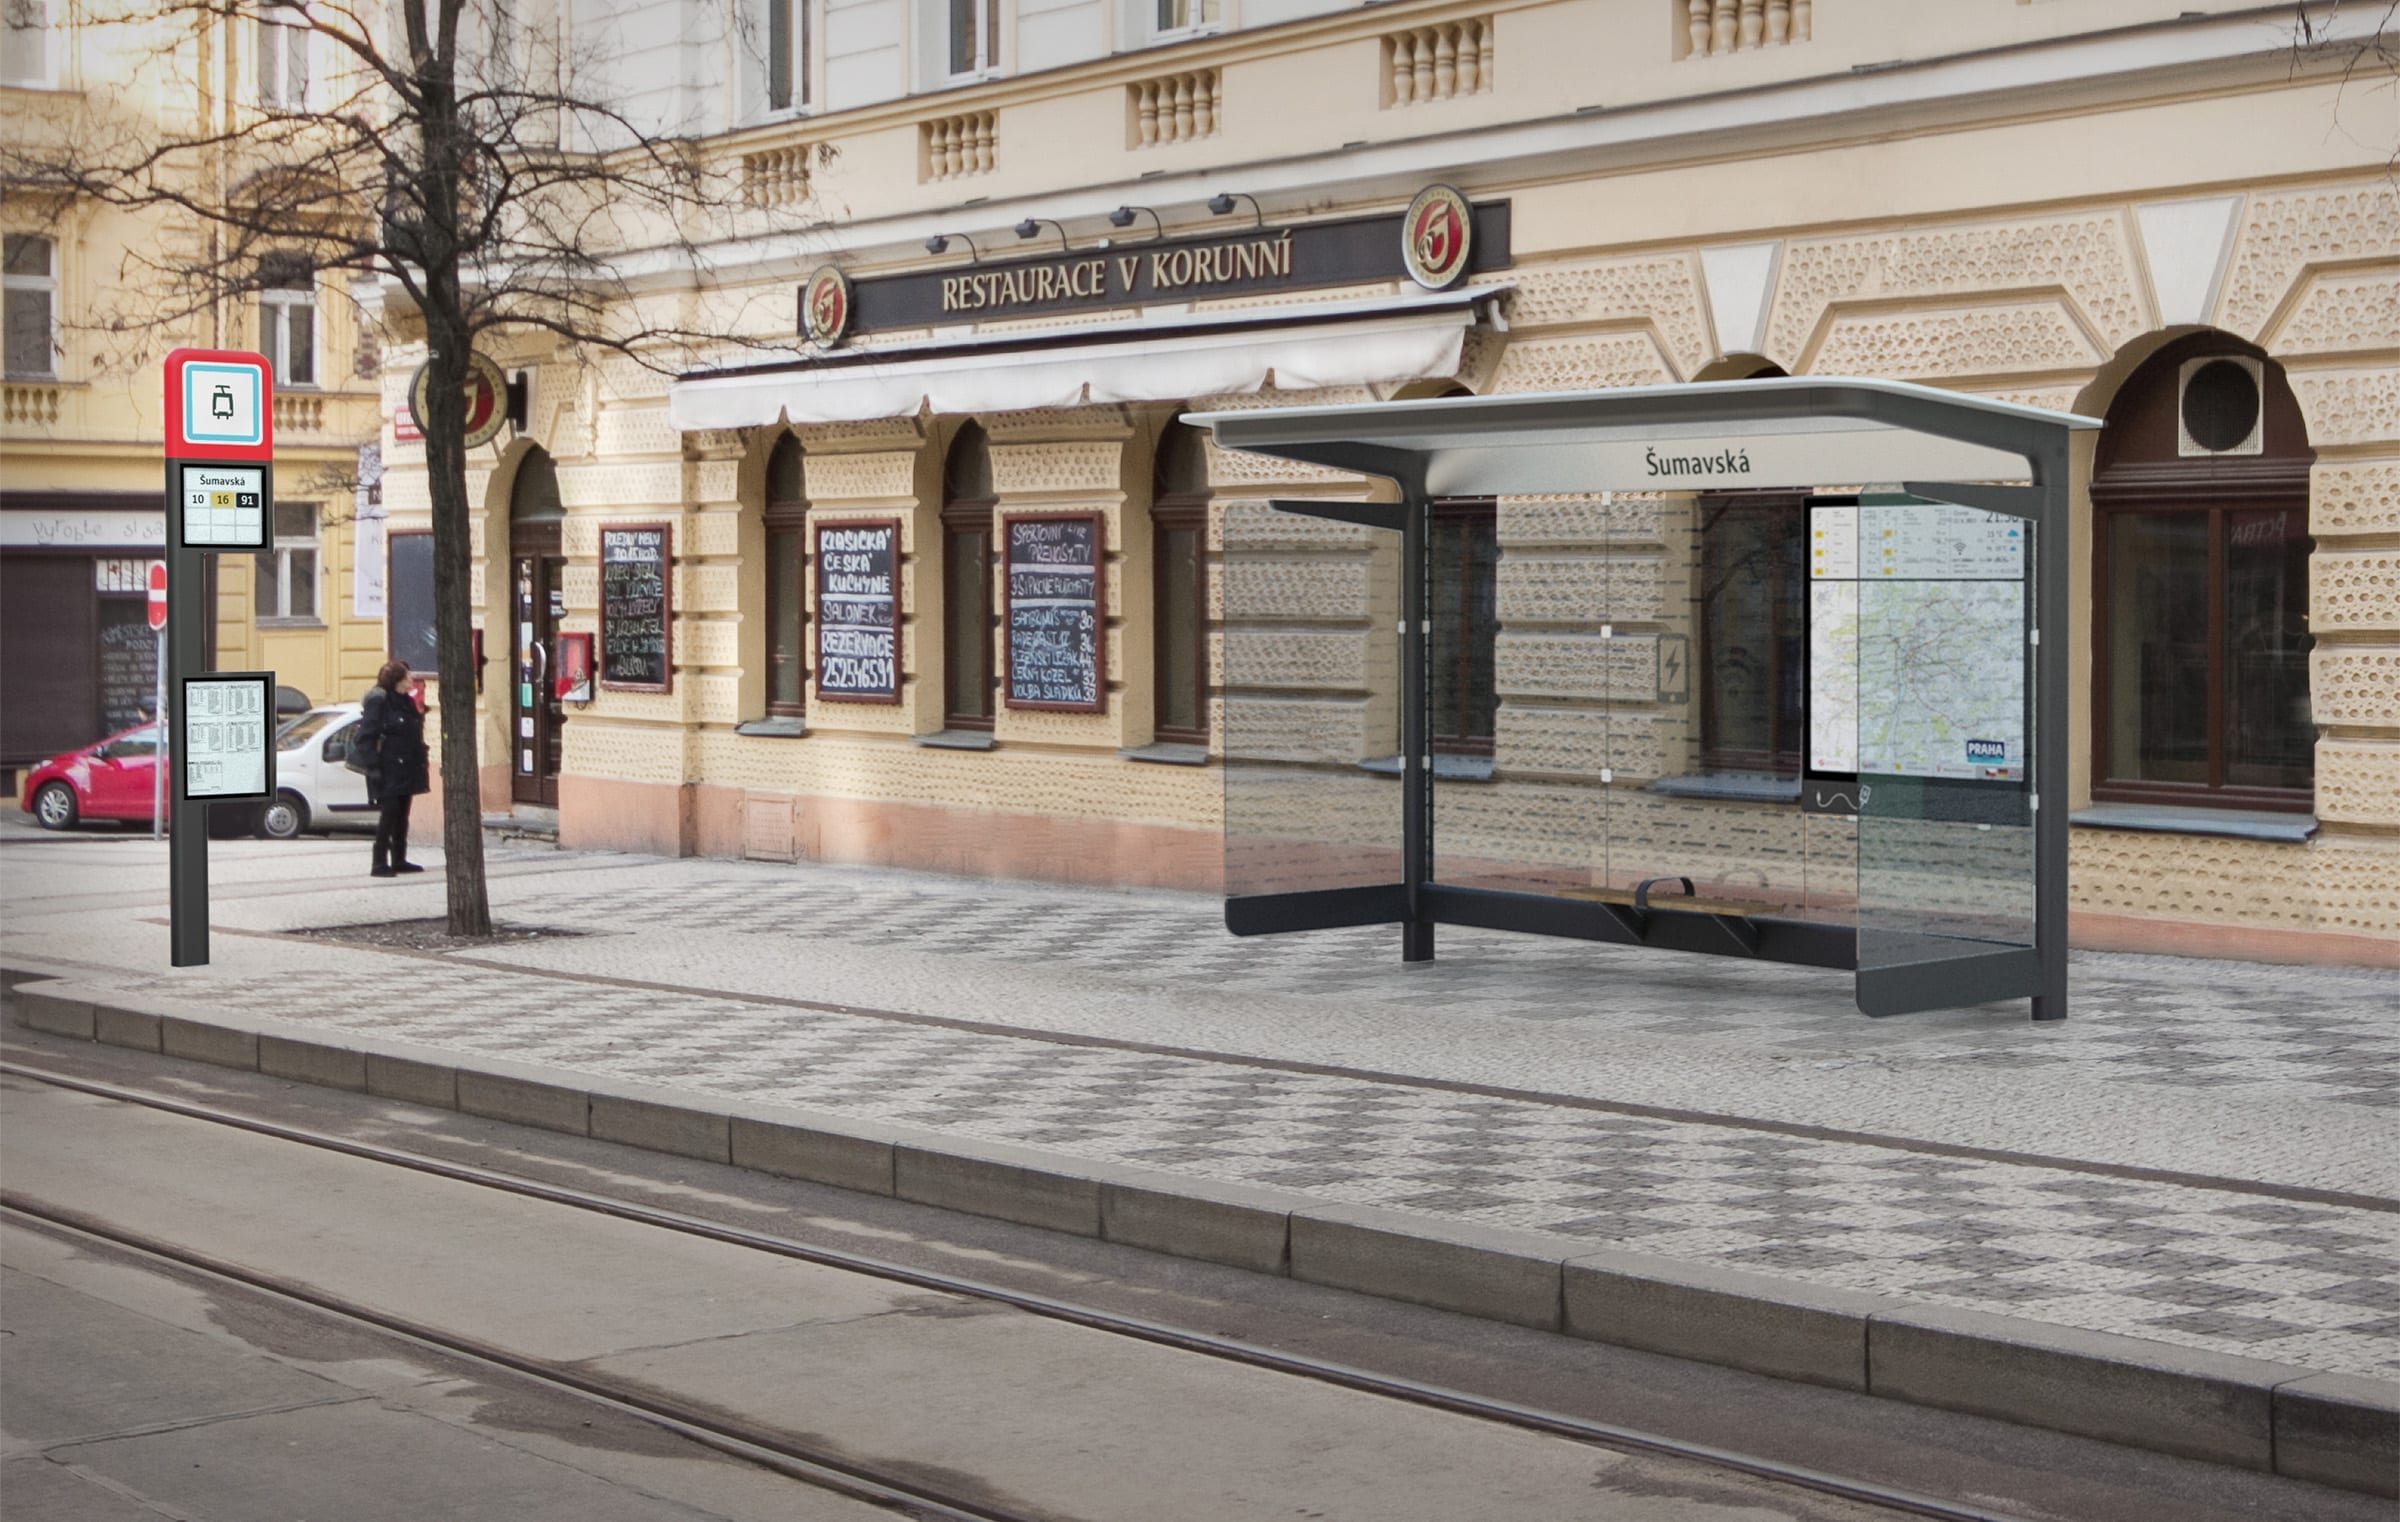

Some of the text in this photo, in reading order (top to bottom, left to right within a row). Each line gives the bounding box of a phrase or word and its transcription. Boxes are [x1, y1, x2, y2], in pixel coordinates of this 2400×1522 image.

[943, 229, 1294, 312] RESTAURACE V KORUNNÍ
[1646, 445, 1750, 476] Šumavská
[200, 474, 246, 486] Šumavská
[192, 494, 204, 504] 10
[217, 494, 229, 505] 16
[241, 495, 254, 505] 91
[821, 528, 892, 552] KLASICKÁ
[823, 552, 873, 573] ČESKÁ
[829, 572, 891, 594] KUCHYNĚ
[822, 601, 878, 625] SALONEK
[821, 631, 895, 658] REZERVACE
[822, 657, 895, 689] 252546591
[1968, 742, 2004, 756] PRAHA
